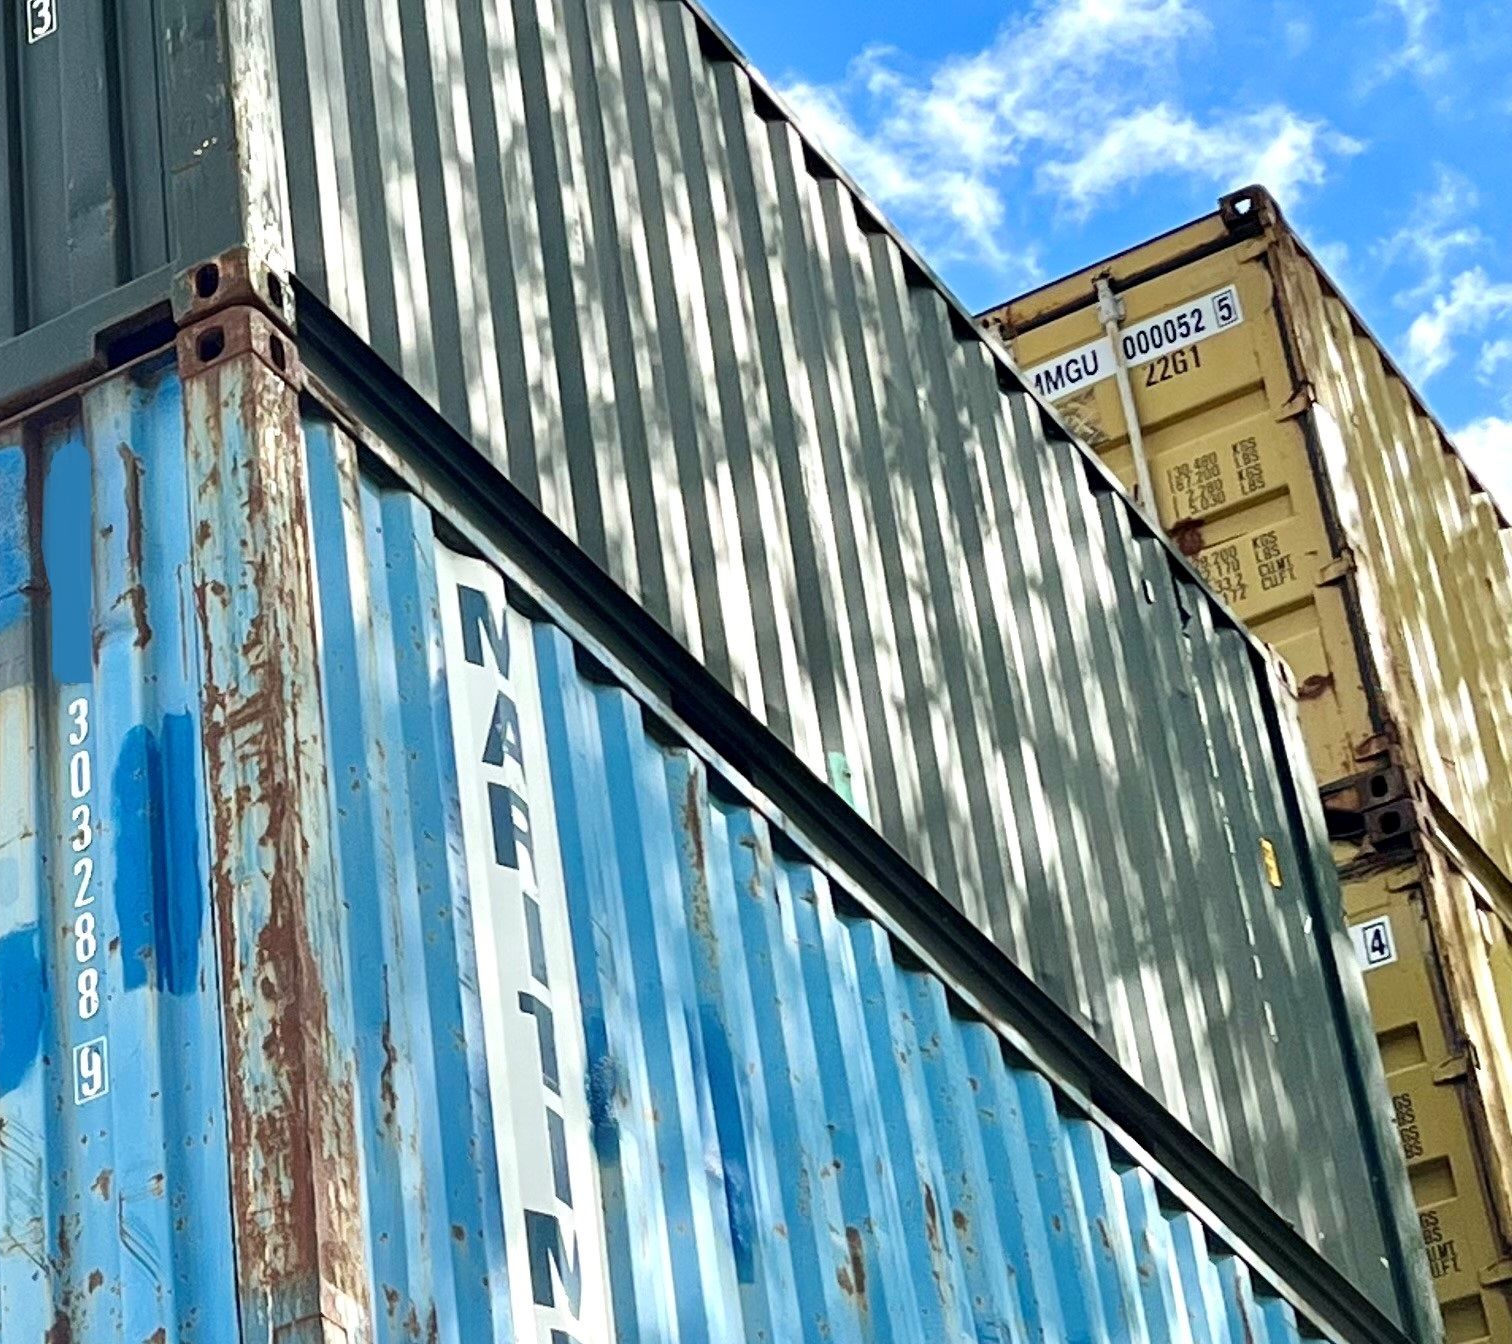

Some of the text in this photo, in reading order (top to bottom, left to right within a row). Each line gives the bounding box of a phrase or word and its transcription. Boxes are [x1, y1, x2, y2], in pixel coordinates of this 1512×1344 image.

[1122, 307, 1206, 360] 000052
[1216, 294, 1234, 324] 5
[1144, 344, 1202, 388] 22G1
[67, 696, 104, 1100] 303288 9
[1368, 928, 1385, 956] 4
